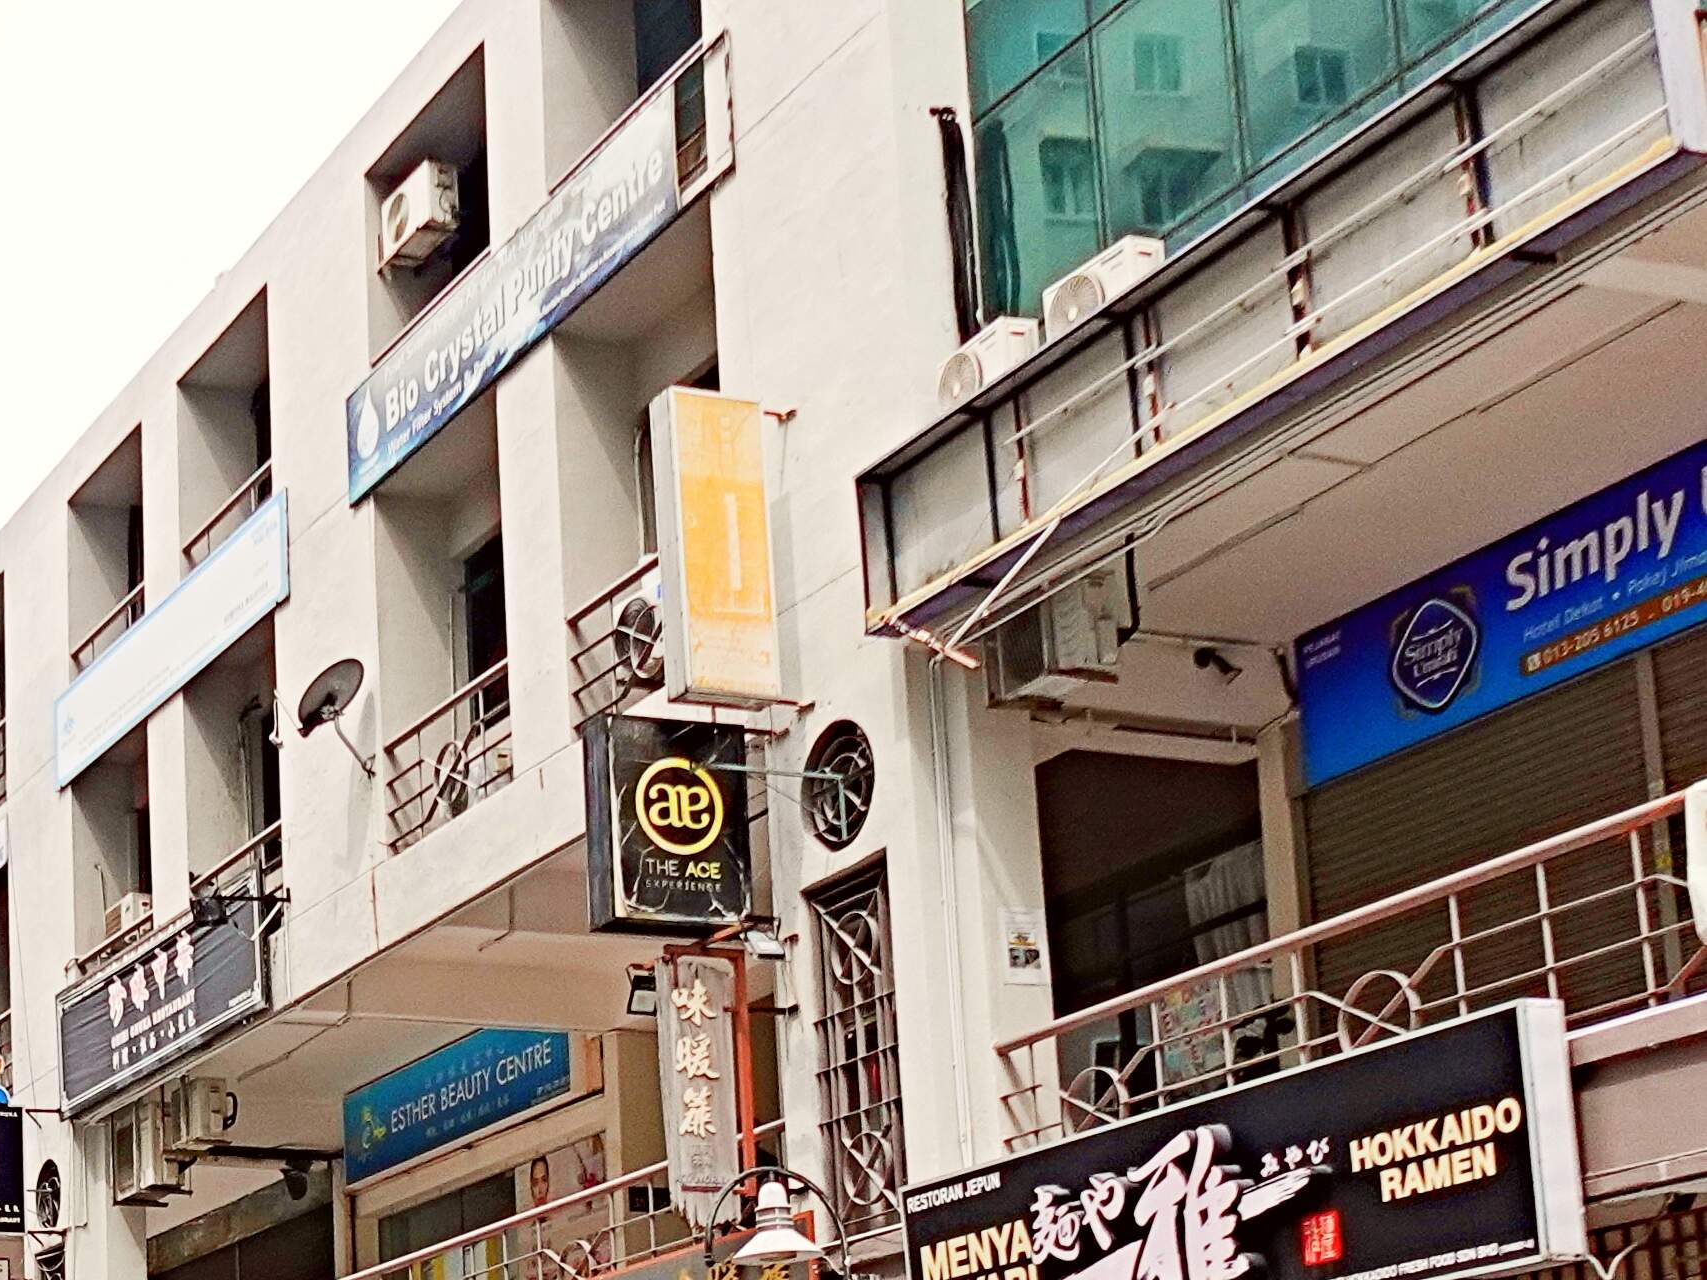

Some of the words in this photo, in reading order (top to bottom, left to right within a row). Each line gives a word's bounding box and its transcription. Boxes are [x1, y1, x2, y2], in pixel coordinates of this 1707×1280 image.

[385, 376, 420, 433] Bio
[424, 294, 507, 393] Crystal
[511, 226, 577, 319] Purify
[581, 148, 664, 247] Centre
[1505, 489, 1685, 612] Simply
[1403, 627, 1464, 666] Simply
[645, 858, 680, 877] THE
[684, 860, 722, 879] ACE
[645, 879, 722, 893] EXPERIENCE
[391, 1092, 436, 1133] ESTHER
[440, 1066, 492, 1112] BEAUTY
[495, 1037, 552, 1086] CENTRE
[1349, 1097, 1522, 1173] HOKKAIDO
[906, 1182, 964, 1214] RESTORAN
[964, 1171, 1001, 1199] JEPUN
[1379, 1142, 1497, 1203] RAMEN
